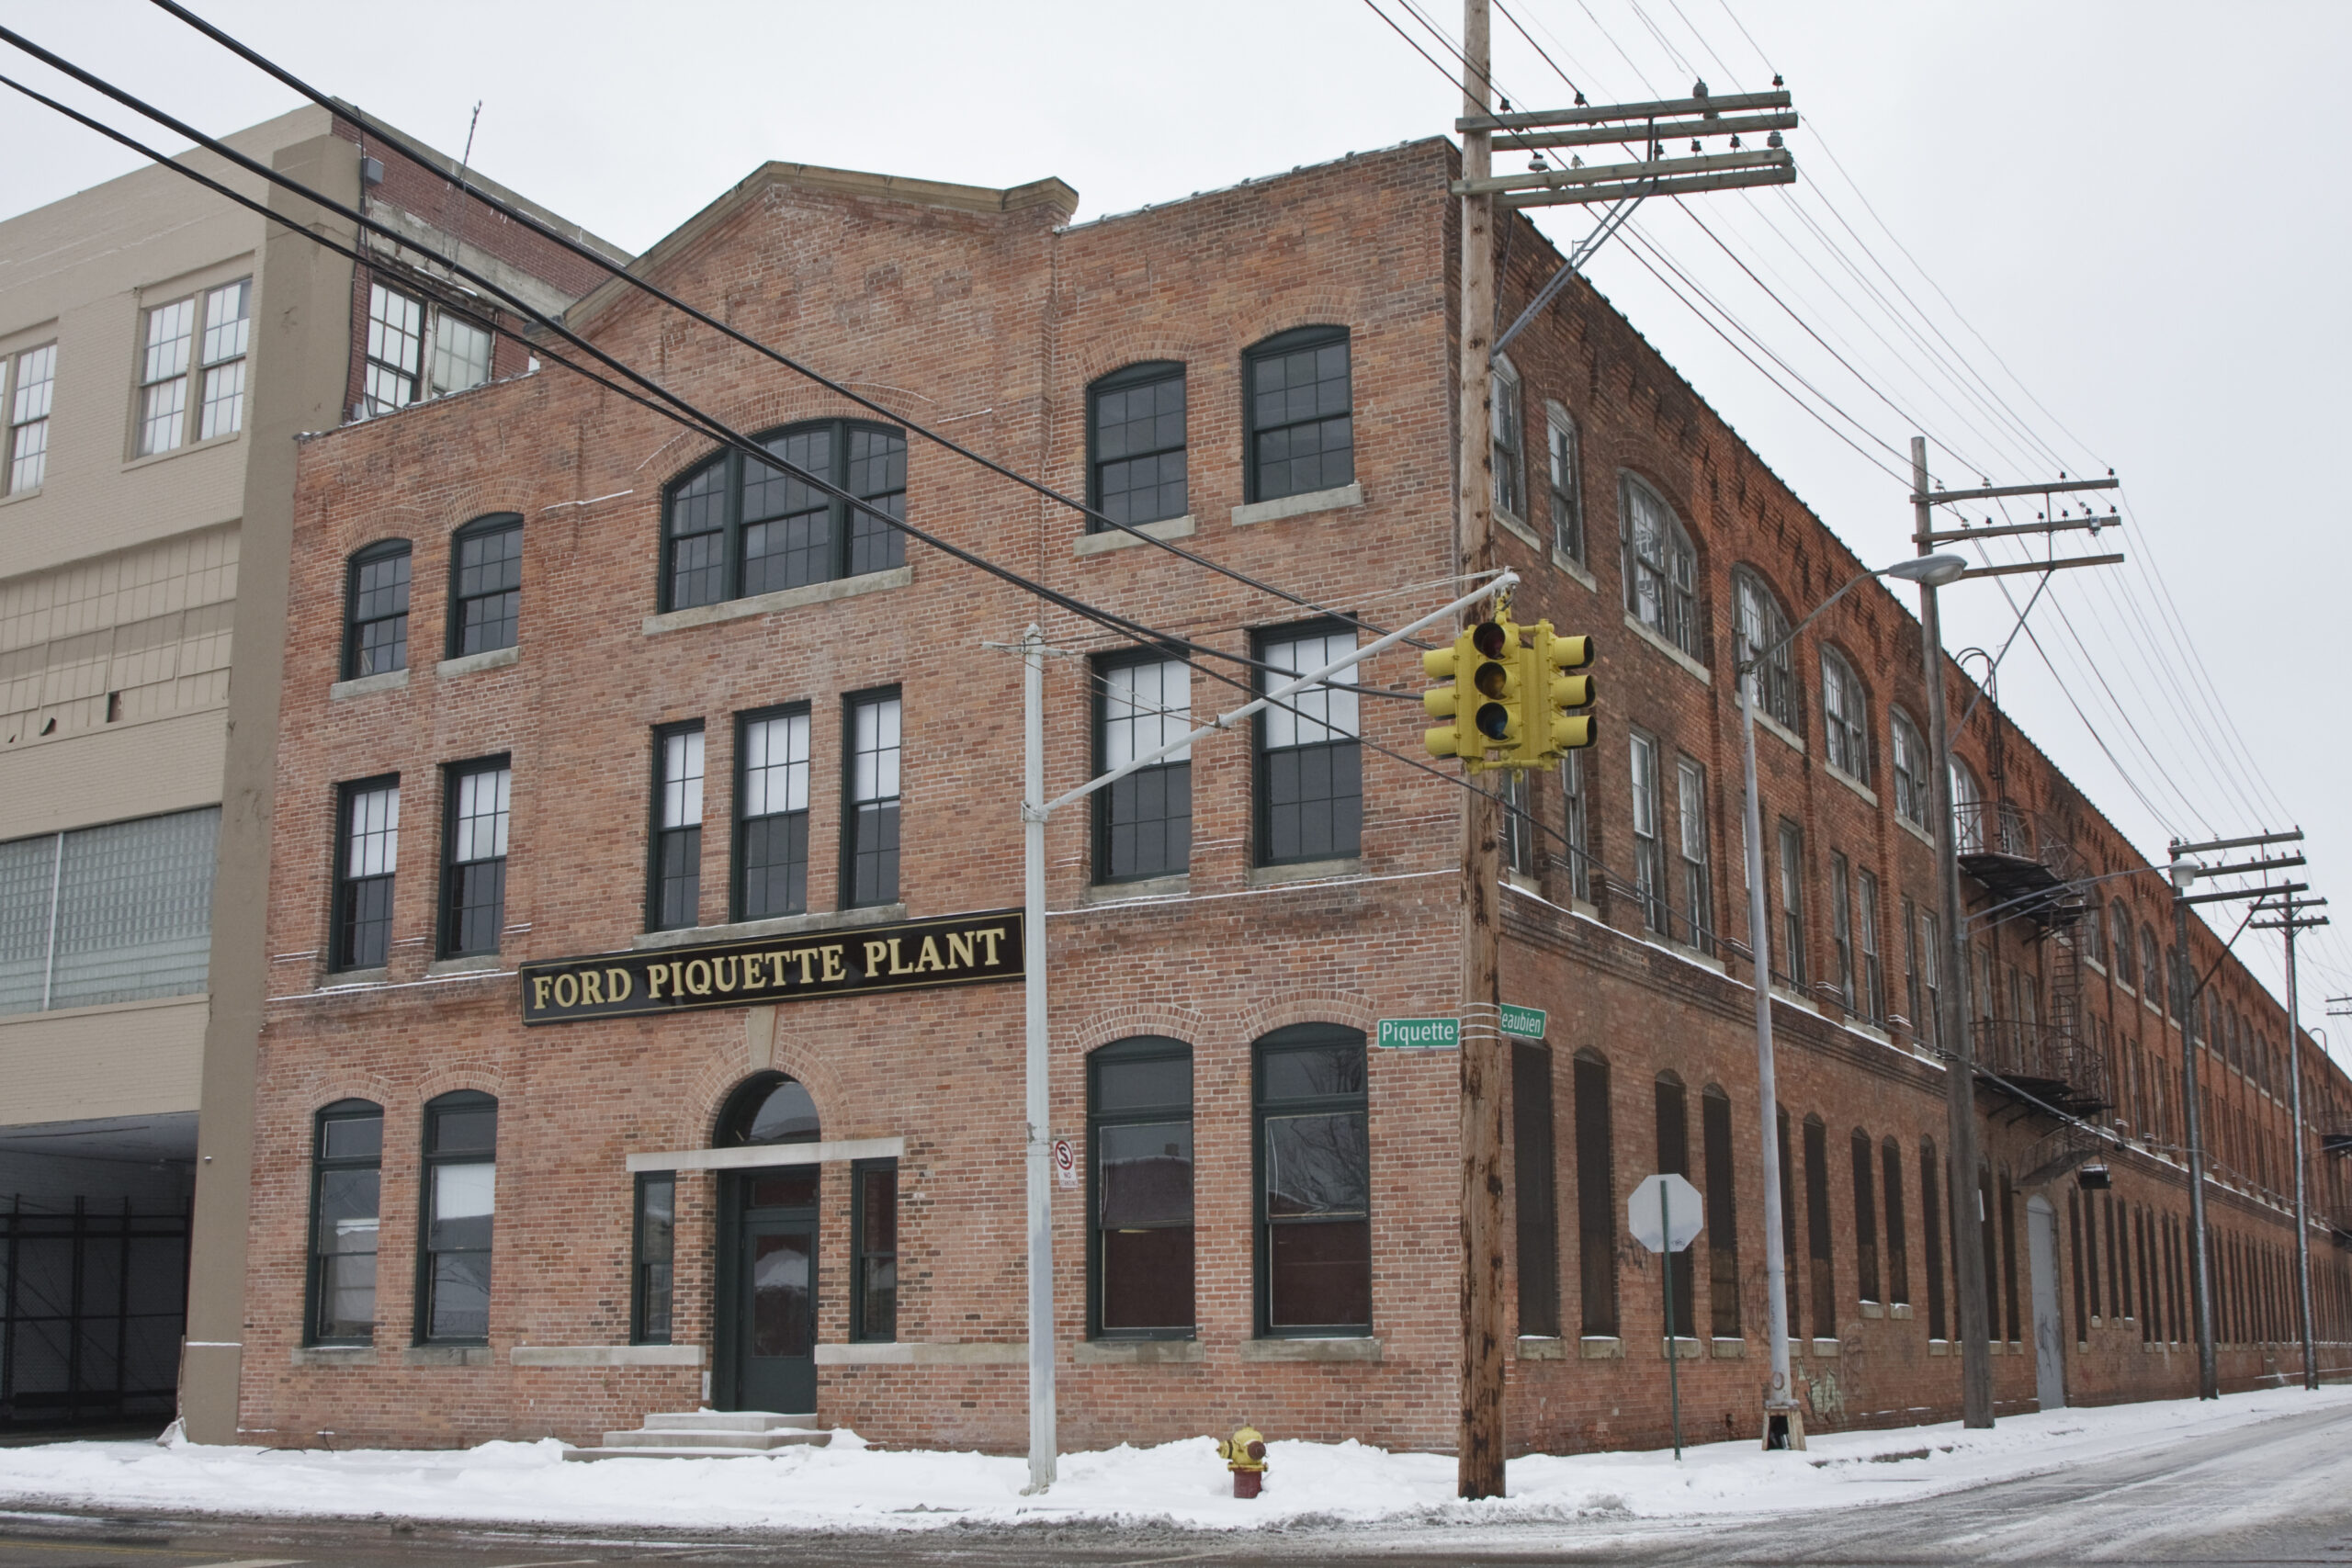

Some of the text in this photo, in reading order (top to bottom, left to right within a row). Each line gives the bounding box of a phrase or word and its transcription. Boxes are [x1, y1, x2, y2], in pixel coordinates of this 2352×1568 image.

[532, 927, 1005, 1010] FORD PIQUETTE PLANT
[1382, 1021, 1454, 1046] Piquette
[1501, 1011, 1542, 1033] eaubien
